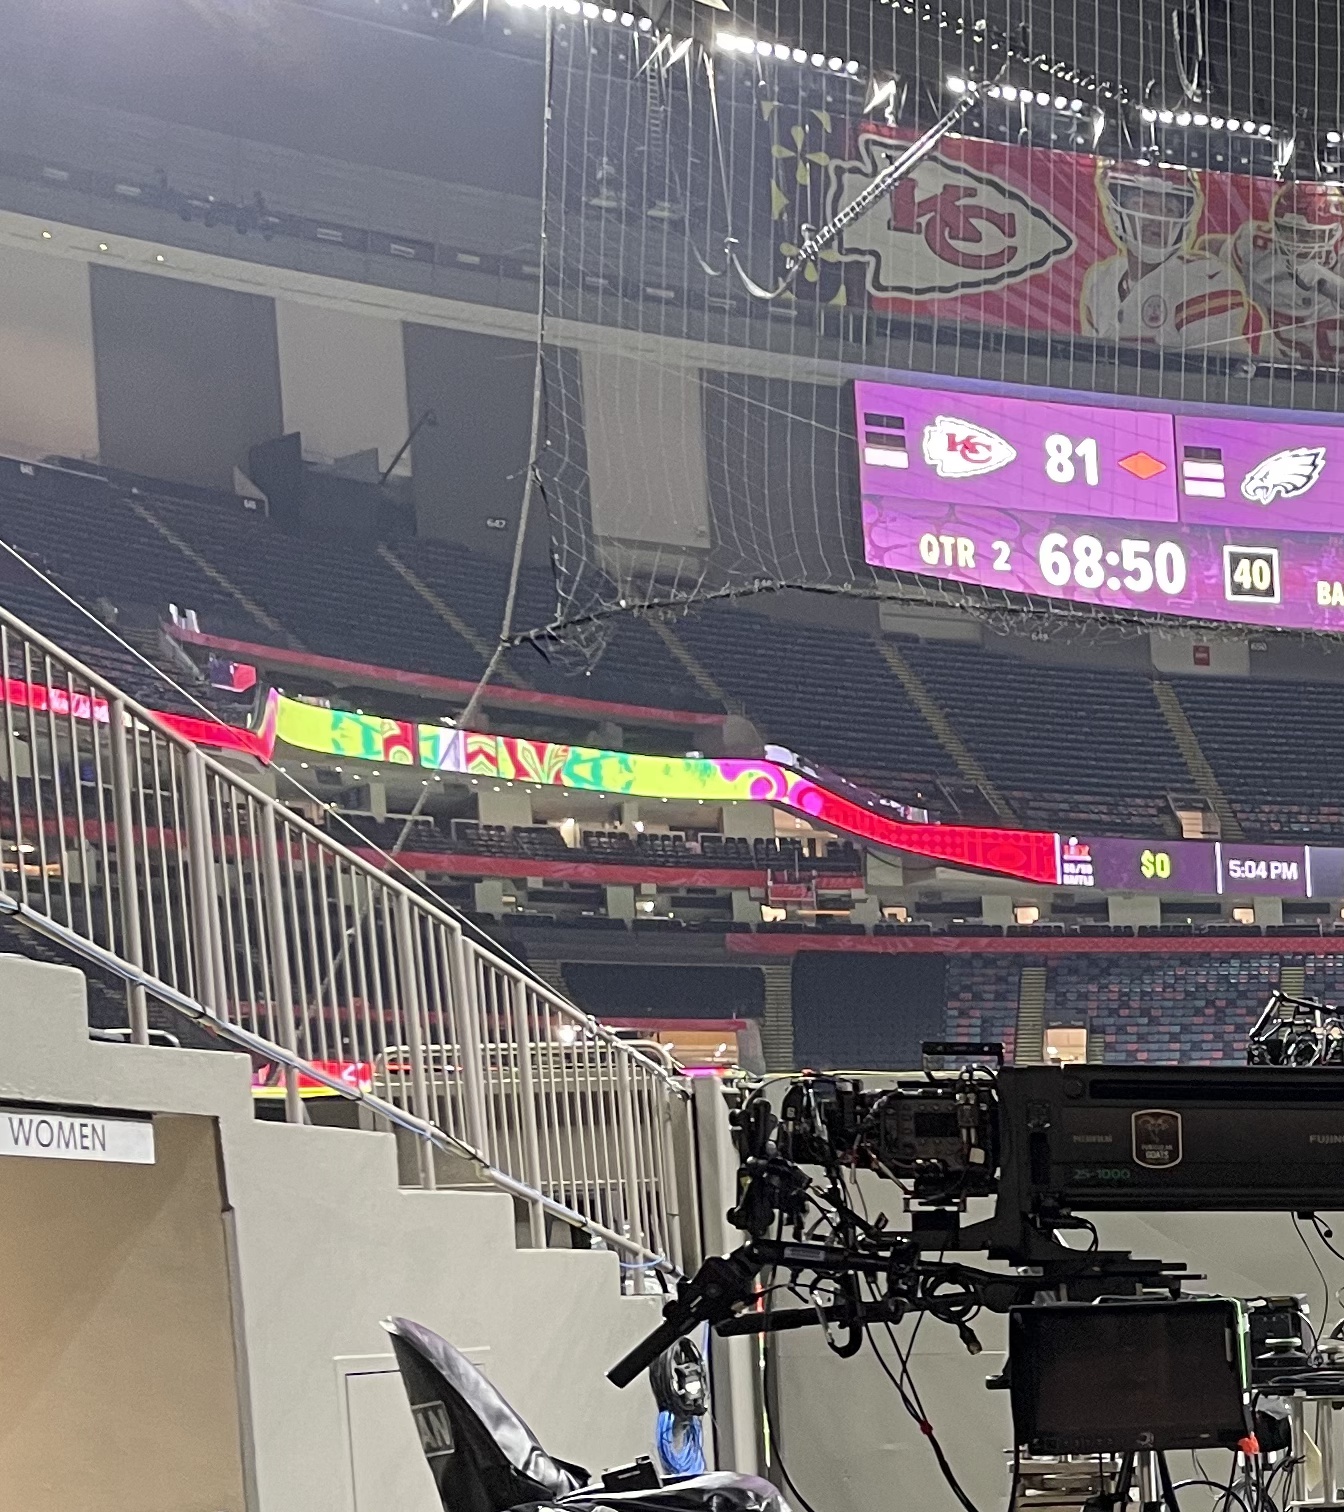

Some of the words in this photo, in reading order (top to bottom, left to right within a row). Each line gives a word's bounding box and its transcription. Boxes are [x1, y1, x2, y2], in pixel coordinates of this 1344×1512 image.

[1044, 433, 1099, 486] 81
[918, 532, 976, 569] QTR
[991, 540, 1012, 571] 2
[1039, 532, 1187, 595] 68:50
[1233, 557, 1272, 591] 40
[1140, 849, 1171, 879] $0
[1228, 859, 1268, 879] 5:04
[1270, 861, 1299, 880] PM
[7, 1116, 107, 1152] WOMEN
